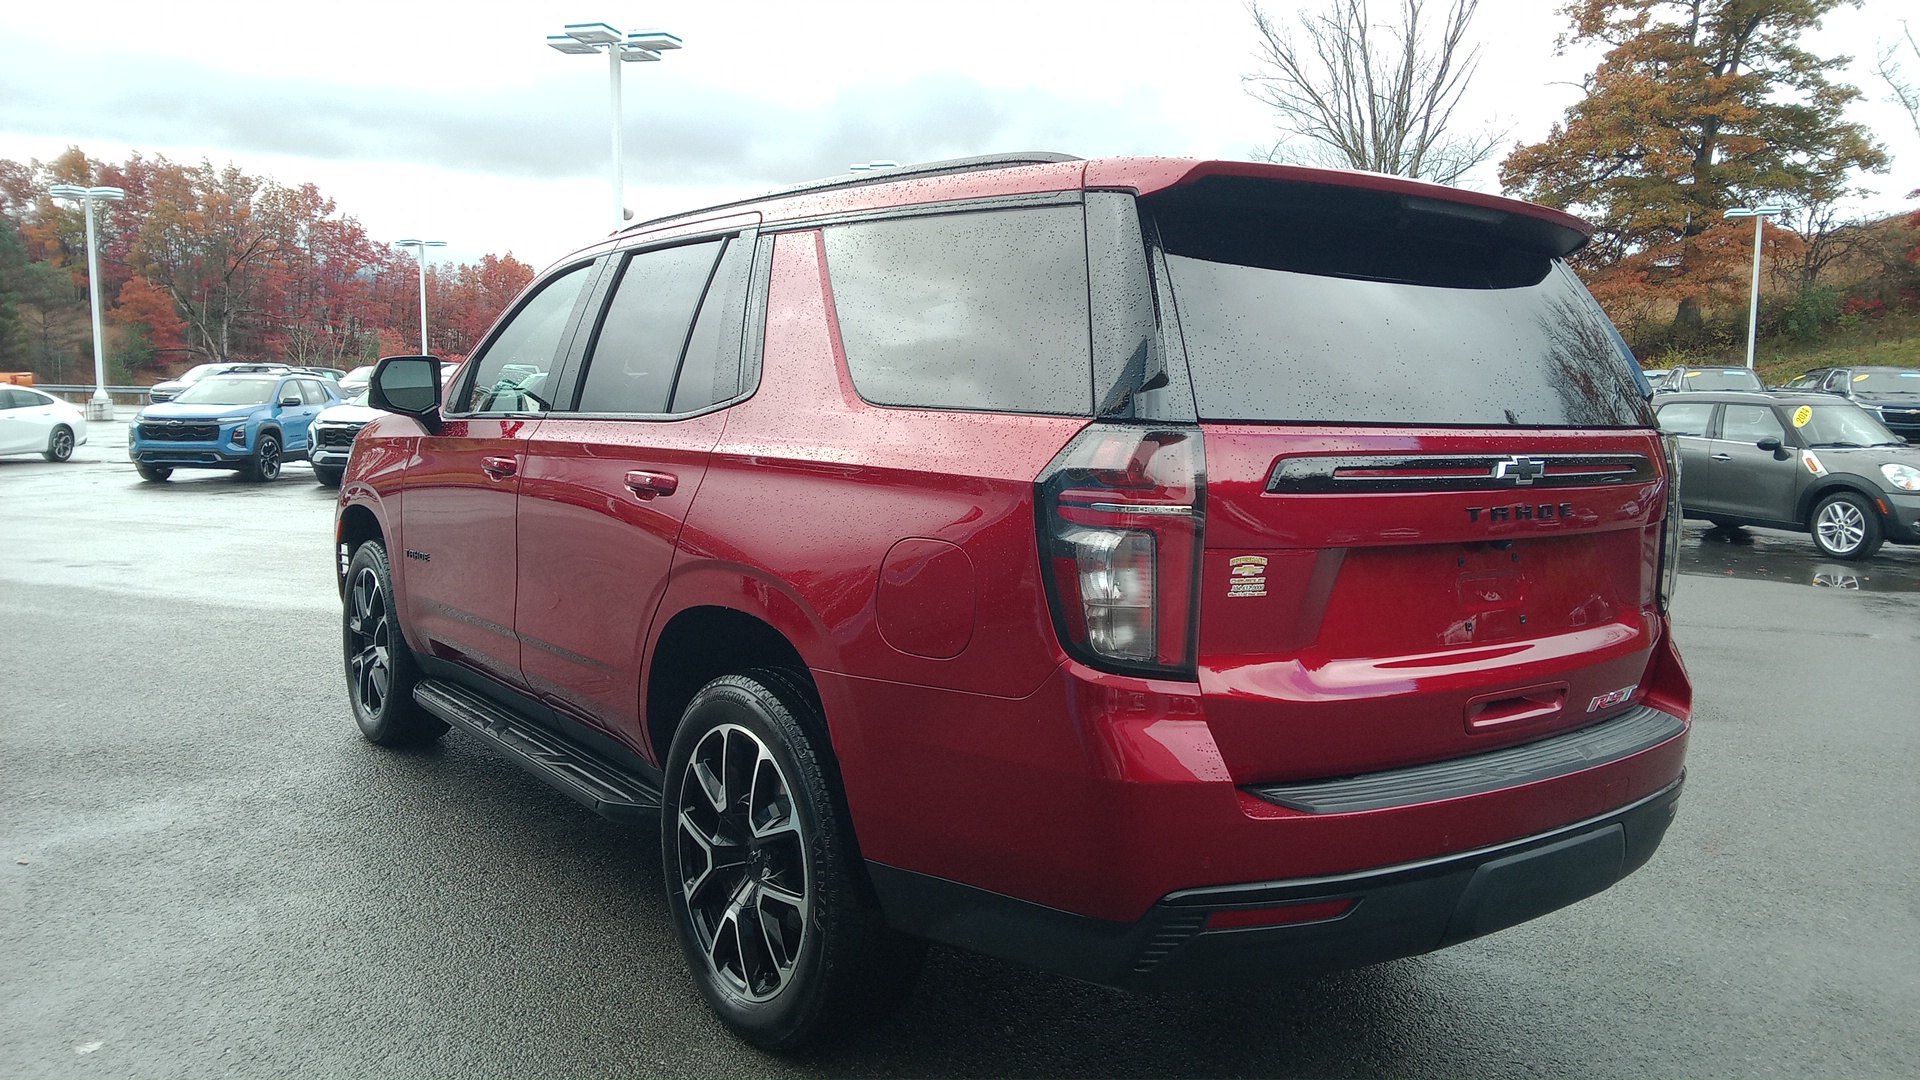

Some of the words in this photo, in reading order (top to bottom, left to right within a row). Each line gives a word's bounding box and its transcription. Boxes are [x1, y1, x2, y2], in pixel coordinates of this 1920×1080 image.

[1796, 407, 1810, 424] 2014
[1465, 502, 1573, 522] TAHOE
[404, 548, 431, 562] TAHOE
[700, 690, 751, 709] BRIDGESTONE
[1586, 684, 1638, 713] RST
